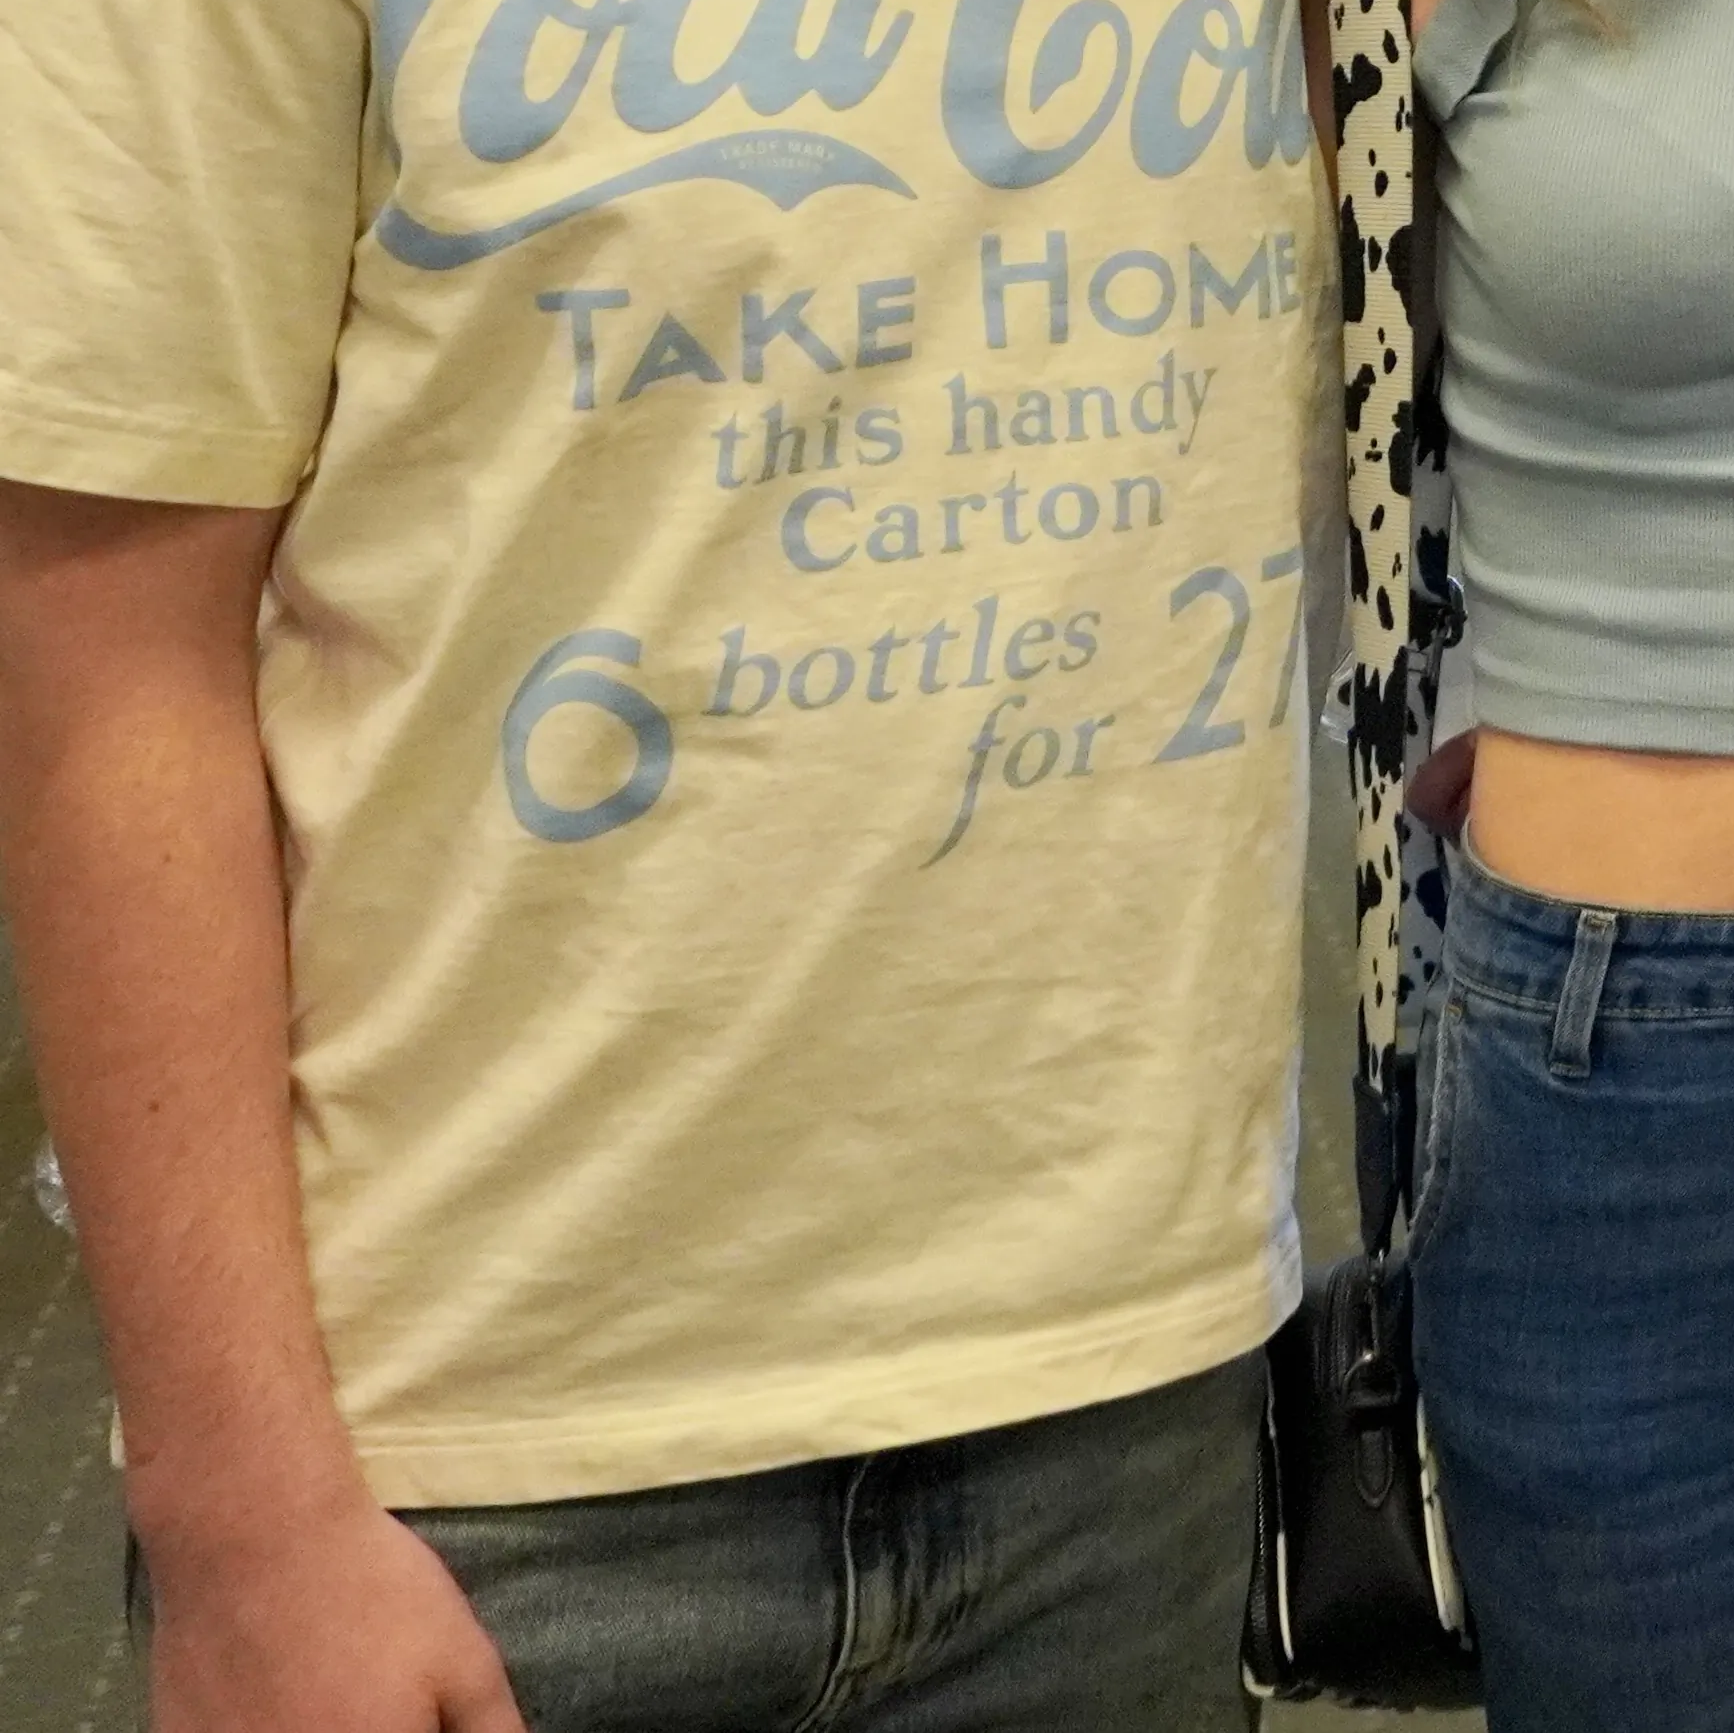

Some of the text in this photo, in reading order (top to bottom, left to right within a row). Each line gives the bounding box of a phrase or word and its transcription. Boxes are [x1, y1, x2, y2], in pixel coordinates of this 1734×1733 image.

[536, 228, 1305, 413] TAKE HOME
[714, 348, 1219, 492] this handy
[780, 469, 1164, 574] Carton
[500, 594, 1103, 844] 6 bottles
[918, 692, 1116, 869] for
